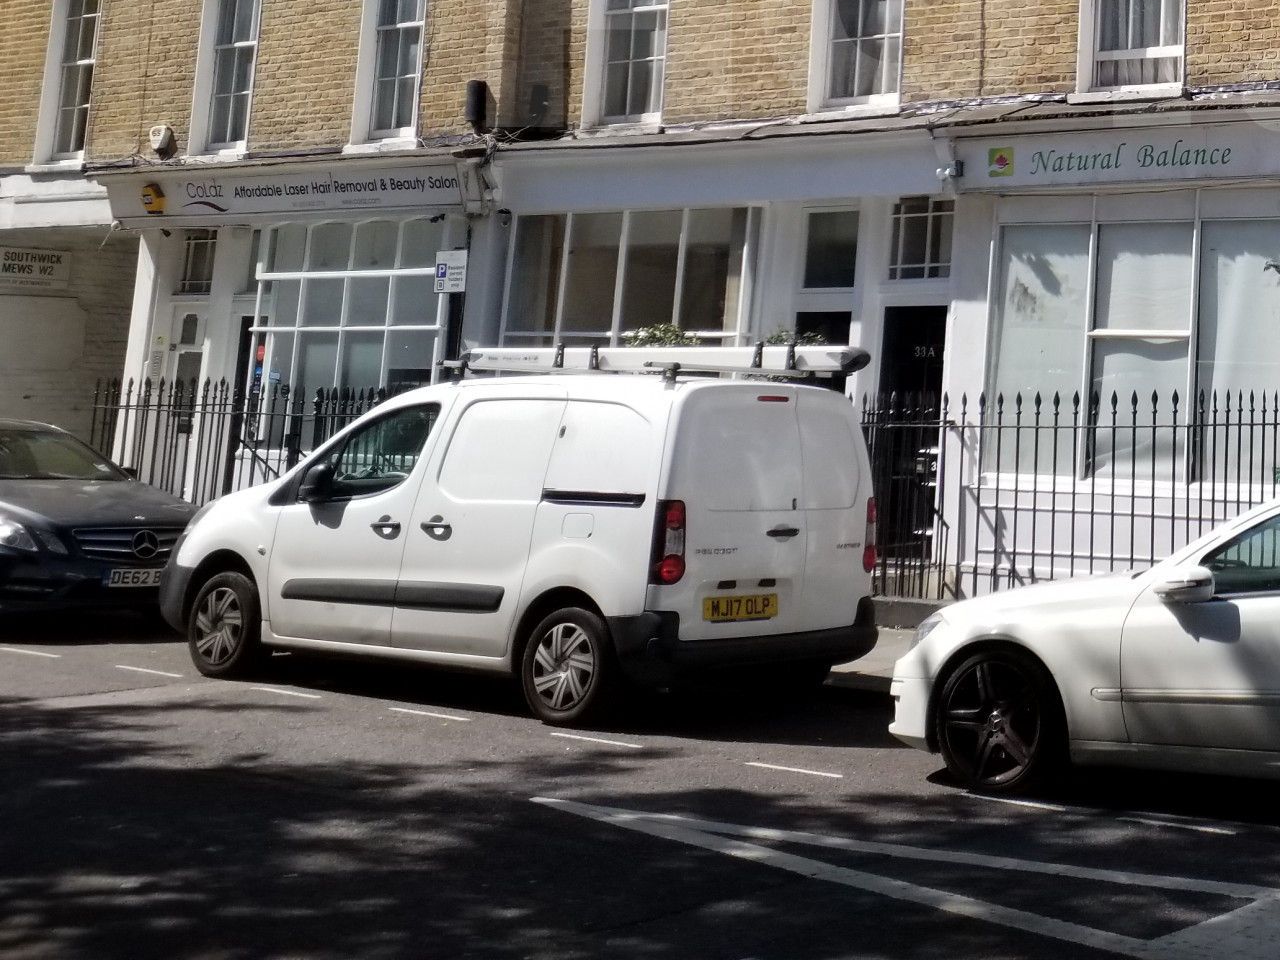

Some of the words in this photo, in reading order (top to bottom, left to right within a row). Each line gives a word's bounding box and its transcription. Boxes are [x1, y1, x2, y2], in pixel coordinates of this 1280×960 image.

[1029, 143, 1127, 175] Natural
[1137, 140, 1232, 168] Balance
[234, 185, 282, 198] Affordable
[284, 183, 309, 196] Laser
[311, 181, 331, 194] Hair
[334, 179, 378, 193] Removal
[380, 179, 388, 190] &
[389, 177, 426, 192] Beauty
[428, 176, 458, 189] Salon
[3, 251, 62, 264] SOUTHWICK
[2, 263, 34, 274] MEWS
[40, 265, 54, 276] W2
[111, 571, 150, 585] DE62
[711, 599, 740, 617] MJ17
[745, 598, 770, 616] OLP
